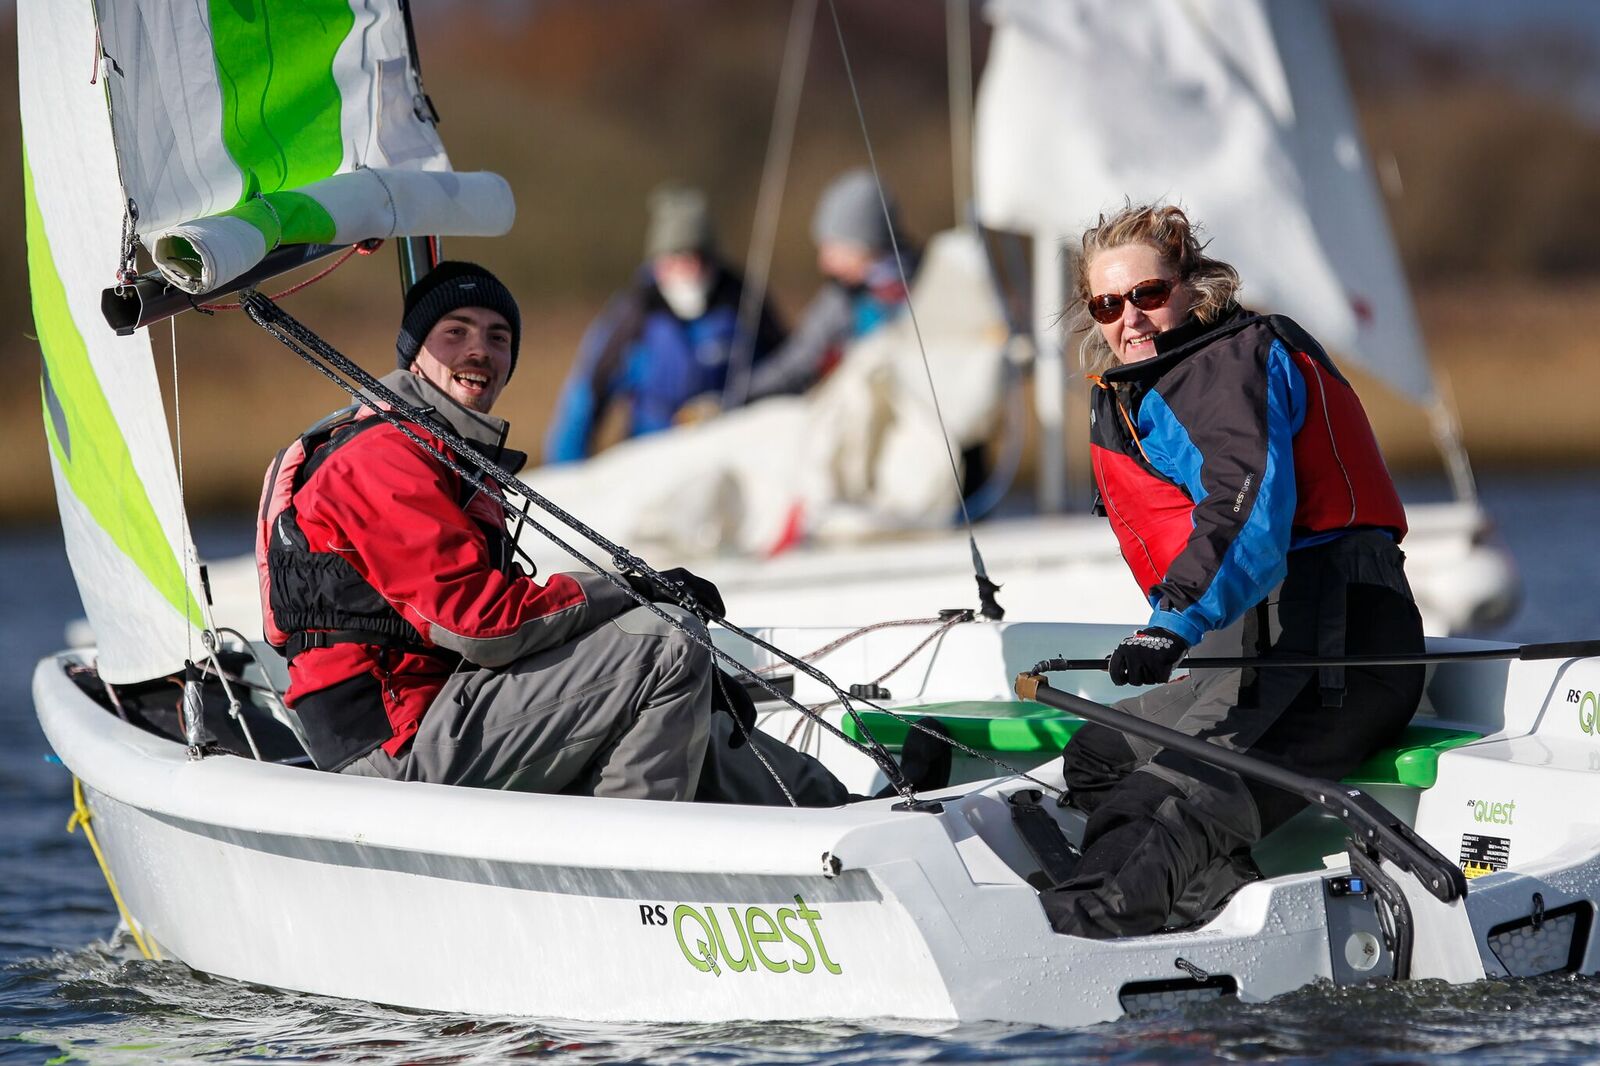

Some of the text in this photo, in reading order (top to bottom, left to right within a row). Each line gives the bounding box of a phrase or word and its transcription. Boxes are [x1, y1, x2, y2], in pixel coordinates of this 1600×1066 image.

[1566, 689, 1600, 736] RS Q
[1466, 799, 1516, 825] RS Quest
[639, 894, 843, 977] RS Quest
